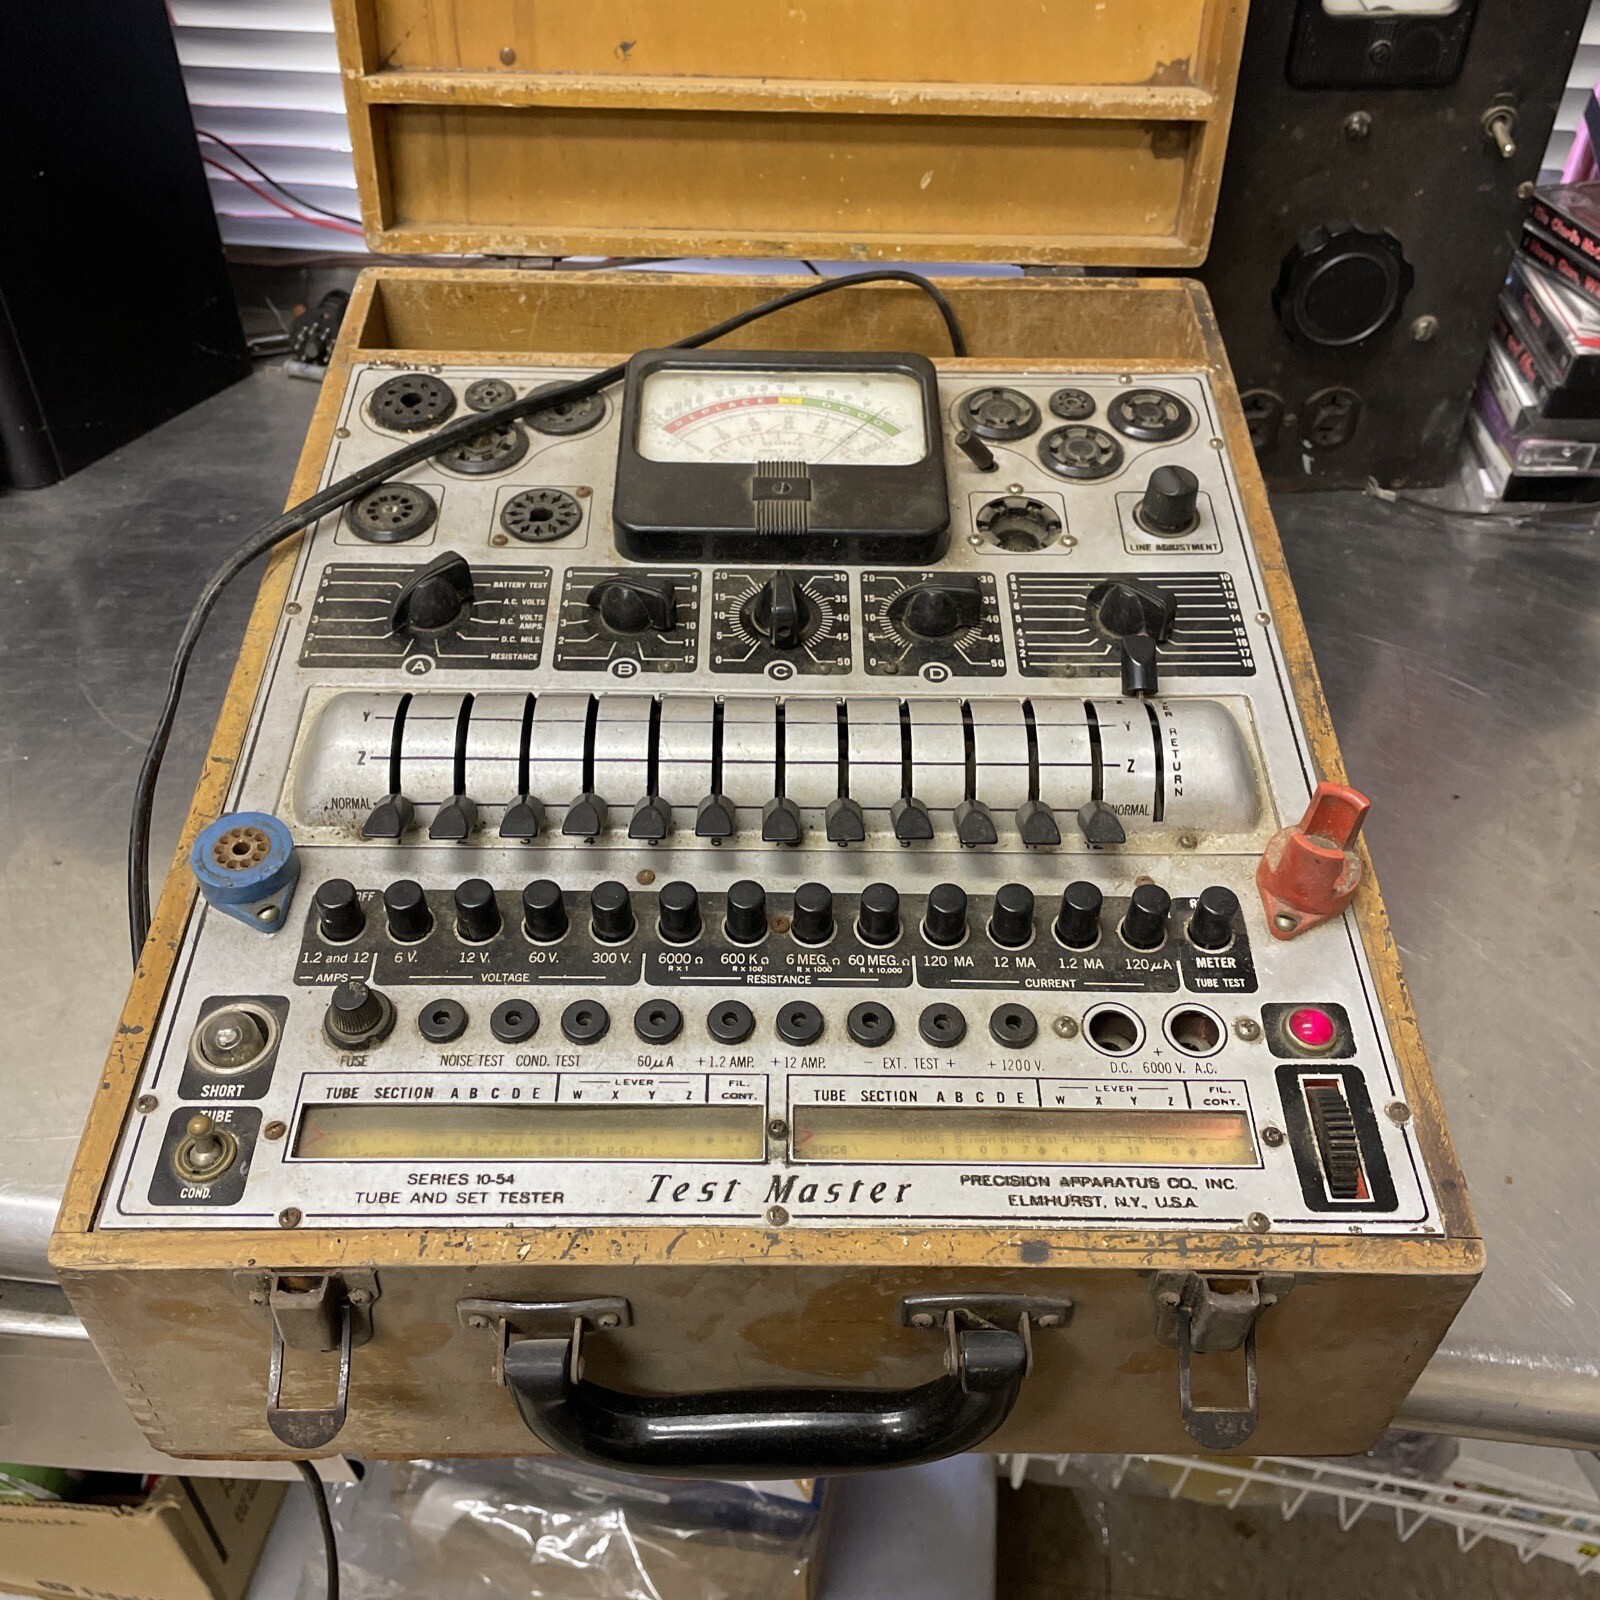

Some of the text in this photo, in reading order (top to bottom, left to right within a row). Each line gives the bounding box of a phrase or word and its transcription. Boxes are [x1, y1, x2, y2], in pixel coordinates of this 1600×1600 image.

[1129, 543, 1219, 551] LINE ADJUSTMENT
[1219, 573, 1231, 581] 10
[322, 579, 328, 587] 5
[493, 581, 547, 589] BATTERY TEST
[522, 598, 545, 606] VOLTS
[1230, 614, 1241, 622] 14
[519, 622, 544, 630] AMPS.
[490, 653, 538, 661] RESISTANCE
[410, 662, 426, 672] A
[618, 664, 633, 674] B
[773, 666, 789, 677] C
[929, 669, 945, 679] D
[363, 712, 370, 721] Y
[1123, 721, 1131, 731] Y
[357, 751, 366, 765] Z
[1169, 728, 1183, 796] RETURN
[1127, 759, 1135, 772] Z
[330, 798, 371, 810] NORMAL
[1112, 805, 1149, 816] NORMAL
[302, 952, 368, 963] 1.2 and 12
[394, 951, 418, 963] 6 V.
[460, 952, 490, 963] 12 V.
[528, 952, 559, 963] 60 V.
[592, 953, 631, 964] 300 V.
[658, 953, 691, 964] 6000
[721, 953, 745, 964] 600
[749, 954, 758, 964] K
[786, 954, 794, 965] 6
[798, 954, 829, 966] MEG.
[848, 955, 864, 966] 60
[867, 955, 899, 966] MEG.
[924, 956, 974, 967] 120 MA
[994, 957, 1036, 968] 12 MA
[1196, 957, 1236, 968] METER
[1059, 958, 1104, 969] 1.2 MA
[1126, 959, 1149, 969] 120
[316, 973, 348, 983] AMPS
[480, 973, 530, 984] VOLTAGE
[747, 974, 811, 984] RESISTANCE
[1025, 979, 1076, 988] CURRENT
[1195, 978, 1245, 988] TUBE TEST
[341, 1055, 369, 1067] FUSE
[440, 1055, 504, 1067] NOISE TEST
[516, 1055, 581, 1067] COND. TEST
[730, 1057, 754, 1068] AMP.
[801, 1057, 826, 1069] AMP.
[883, 1057, 939, 1069] EXT. TEST
[1034, 1060, 1044, 1071] V.
[1111, 1062, 1217, 1074] D.C. 6000 V. A.C.
[201, 1084, 245, 1097] SHORT
[326, 1087, 540, 1099] TUBE SECTION A B C D E
[573, 1091, 692, 1099] W X Y Z
[722, 1092, 757, 1100] CONT.
[814, 1089, 1024, 1103] TUBE SECTION A B C D E
[1056, 1096, 1174, 1105] W X Y Z
[408, 1174, 515, 1185] SERIES 10-54
[961, 1175, 1050, 1187] PRECISION
[1059, 1177, 1160, 1188] APPARATUS
[1206, 1179, 1238, 1189] INC.
[180, 1188, 211, 1199] COND.
[647, 1174, 911, 1204] Test Master
[356, 1192, 564, 1204] TUBE AND SET TESTER
[1009, 1195, 1107, 1209] ELMHURST,
